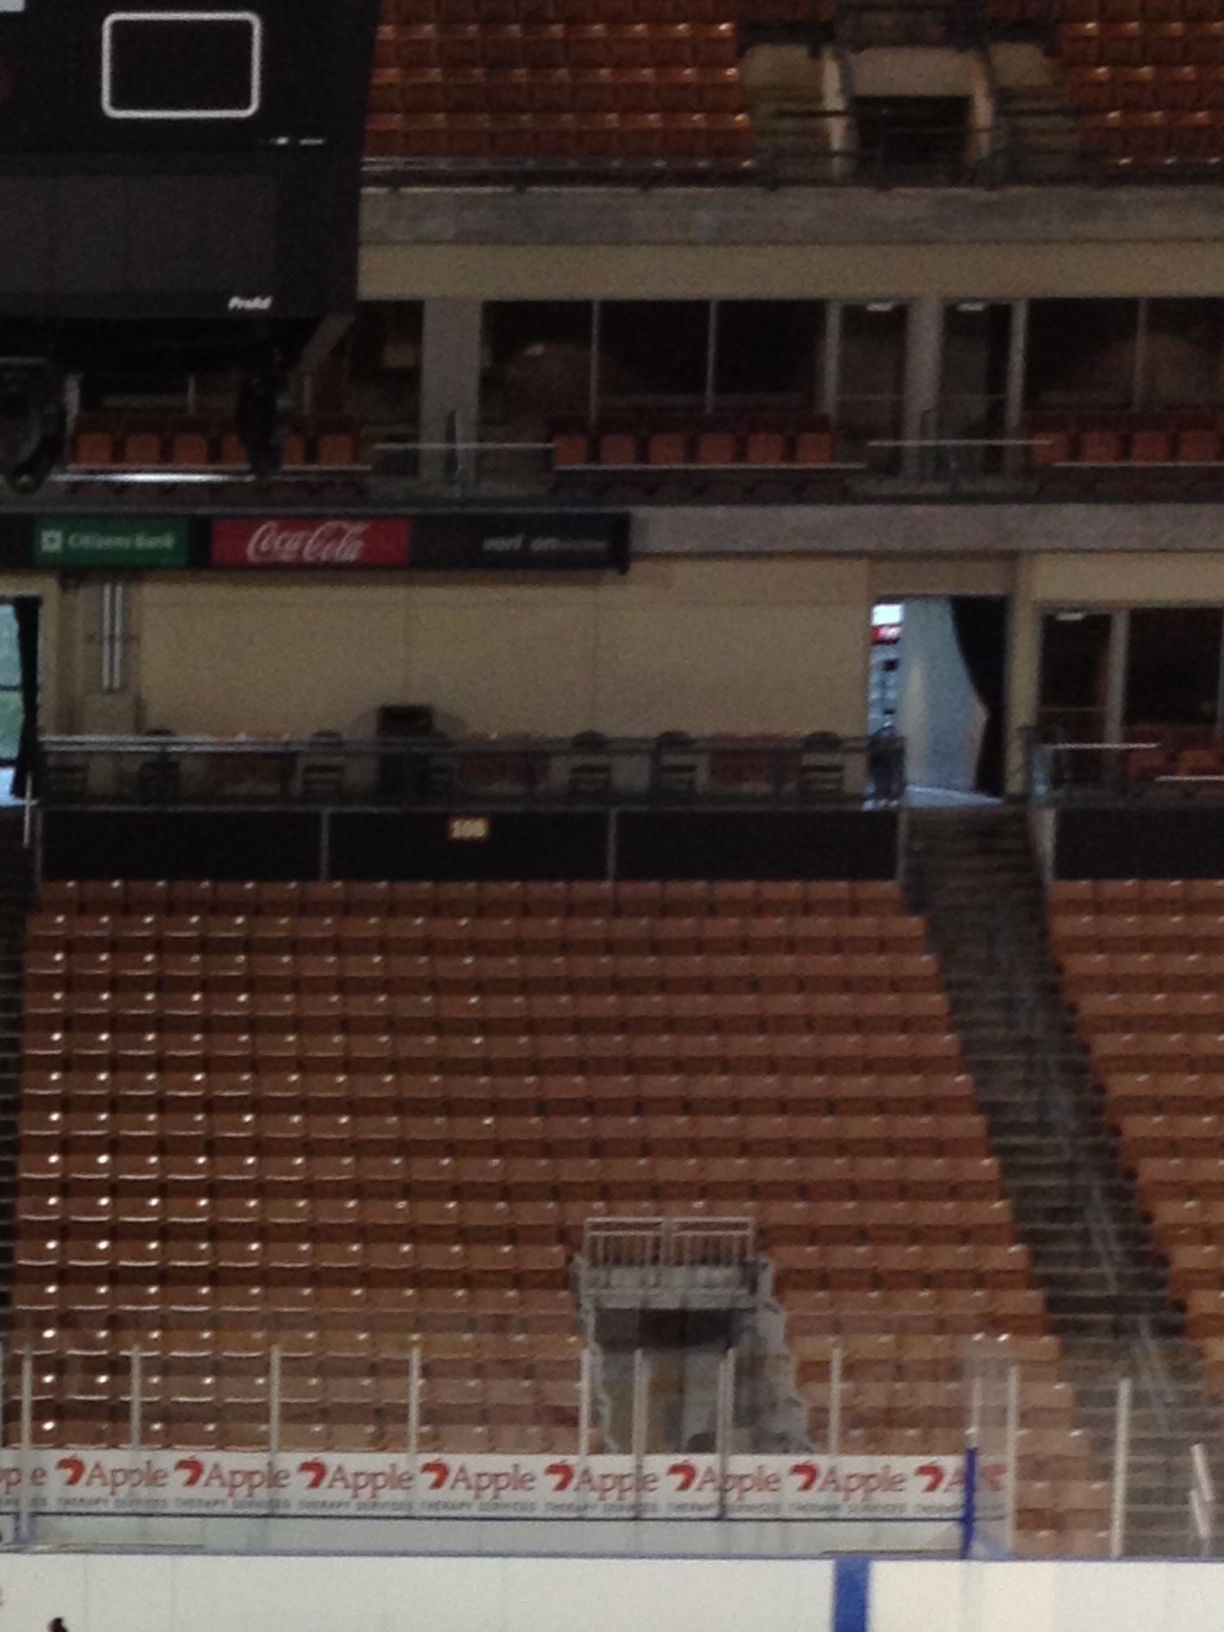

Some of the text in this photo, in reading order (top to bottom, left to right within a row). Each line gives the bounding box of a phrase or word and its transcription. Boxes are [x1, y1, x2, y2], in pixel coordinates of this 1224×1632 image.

[86, 1460, 168, 1496] Apple
[204, 1461, 290, 1498] Apple
[328, 1463, 413, 1499] Apple
[449, 1463, 536, 1500] Apple
[819, 1465, 906, 1501] Apple
